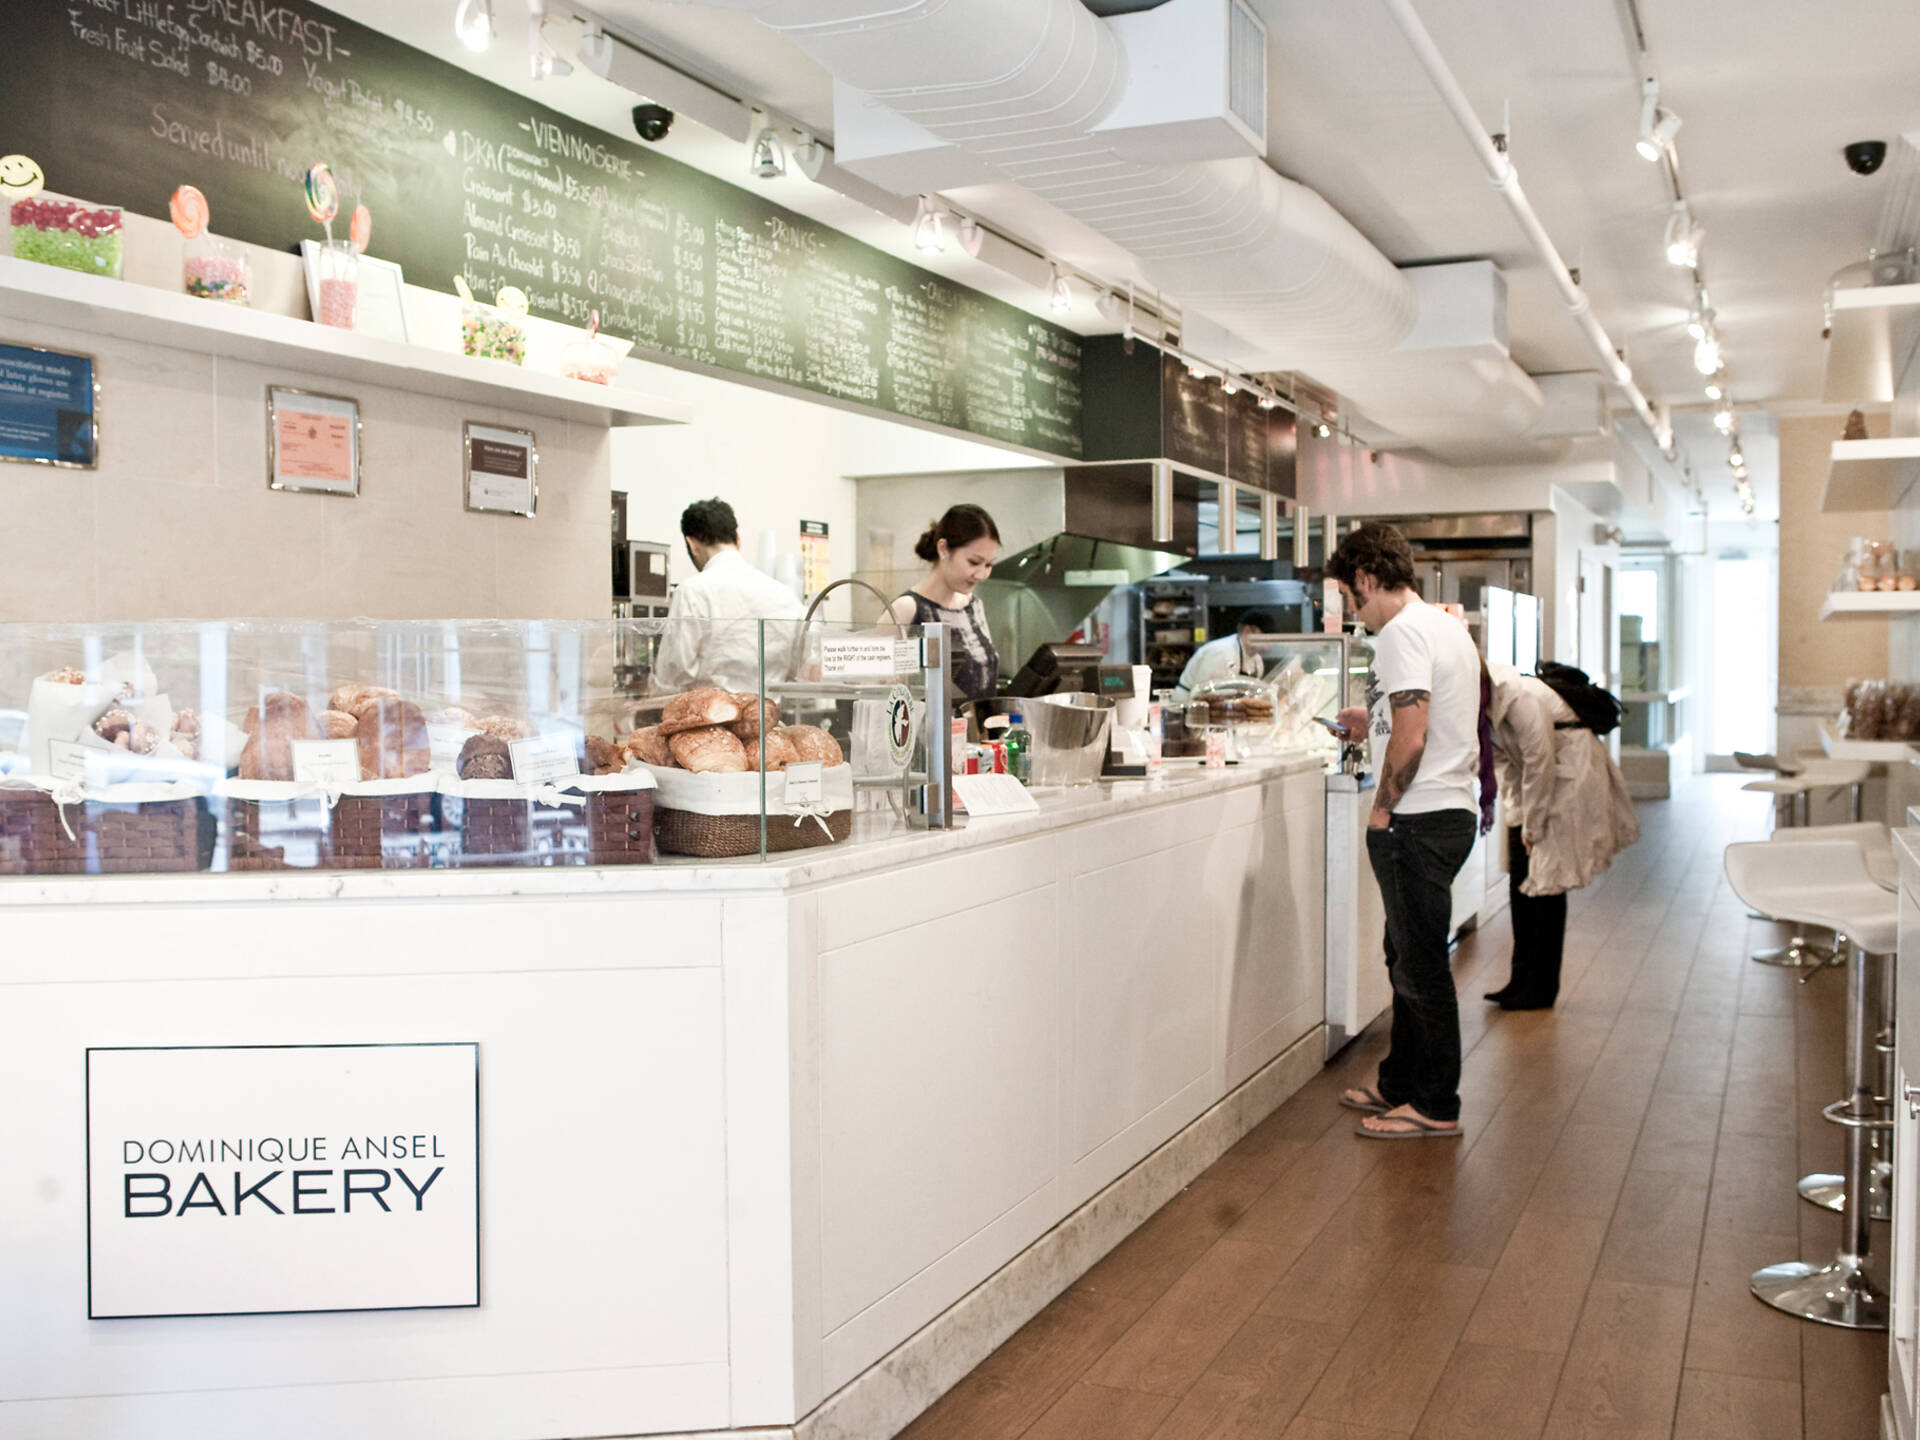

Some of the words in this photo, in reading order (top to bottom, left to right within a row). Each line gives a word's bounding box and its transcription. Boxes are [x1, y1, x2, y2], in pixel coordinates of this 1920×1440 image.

[151, 102, 224, 158] Served
[227, 138, 270, 172] until
[123, 1137, 327, 1164] DOMINIQUE
[341, 1134, 446, 1160] ANSEL
[123, 1166, 446, 1219] BAKERY
